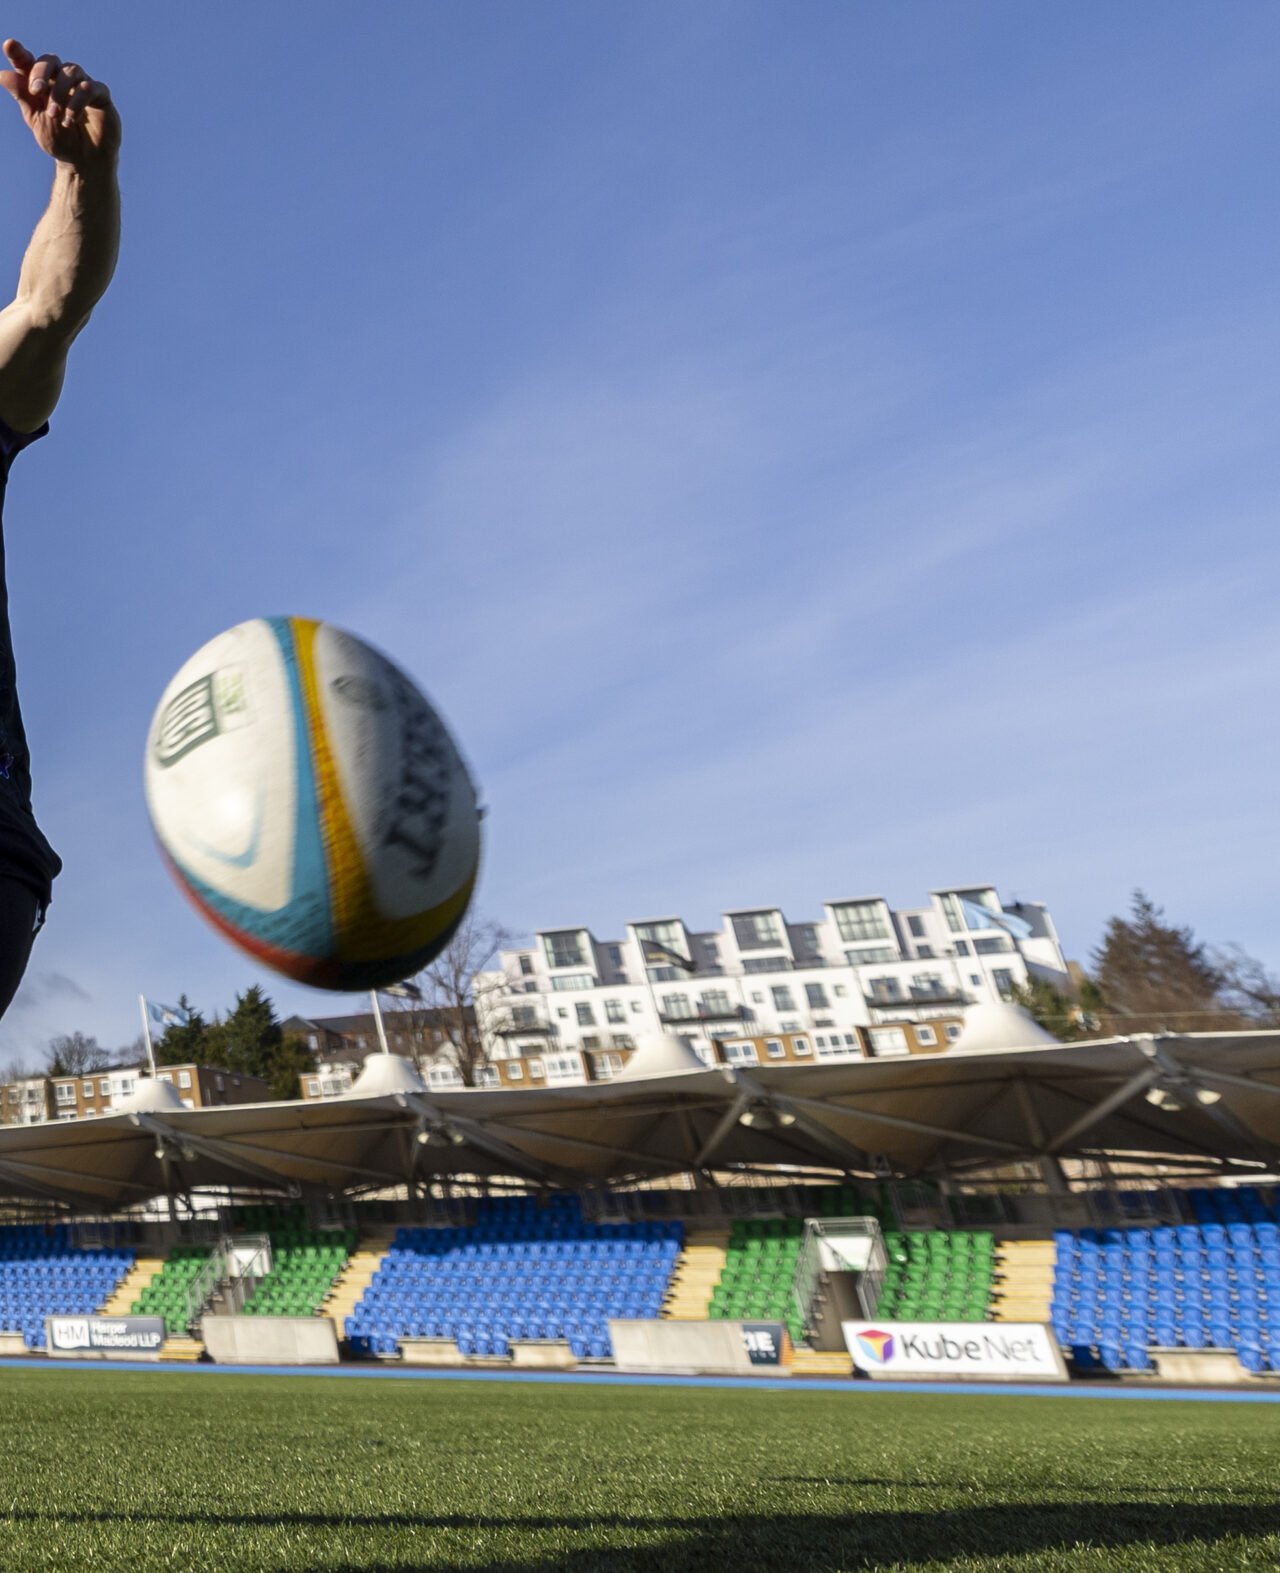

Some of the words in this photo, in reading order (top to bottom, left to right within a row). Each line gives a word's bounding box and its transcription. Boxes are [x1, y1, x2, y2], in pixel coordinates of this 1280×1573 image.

[58, 1325, 86, 1341] HM
[138, 1331, 161, 1348] LLP
[900, 1333, 1042, 1362] KubeNet
